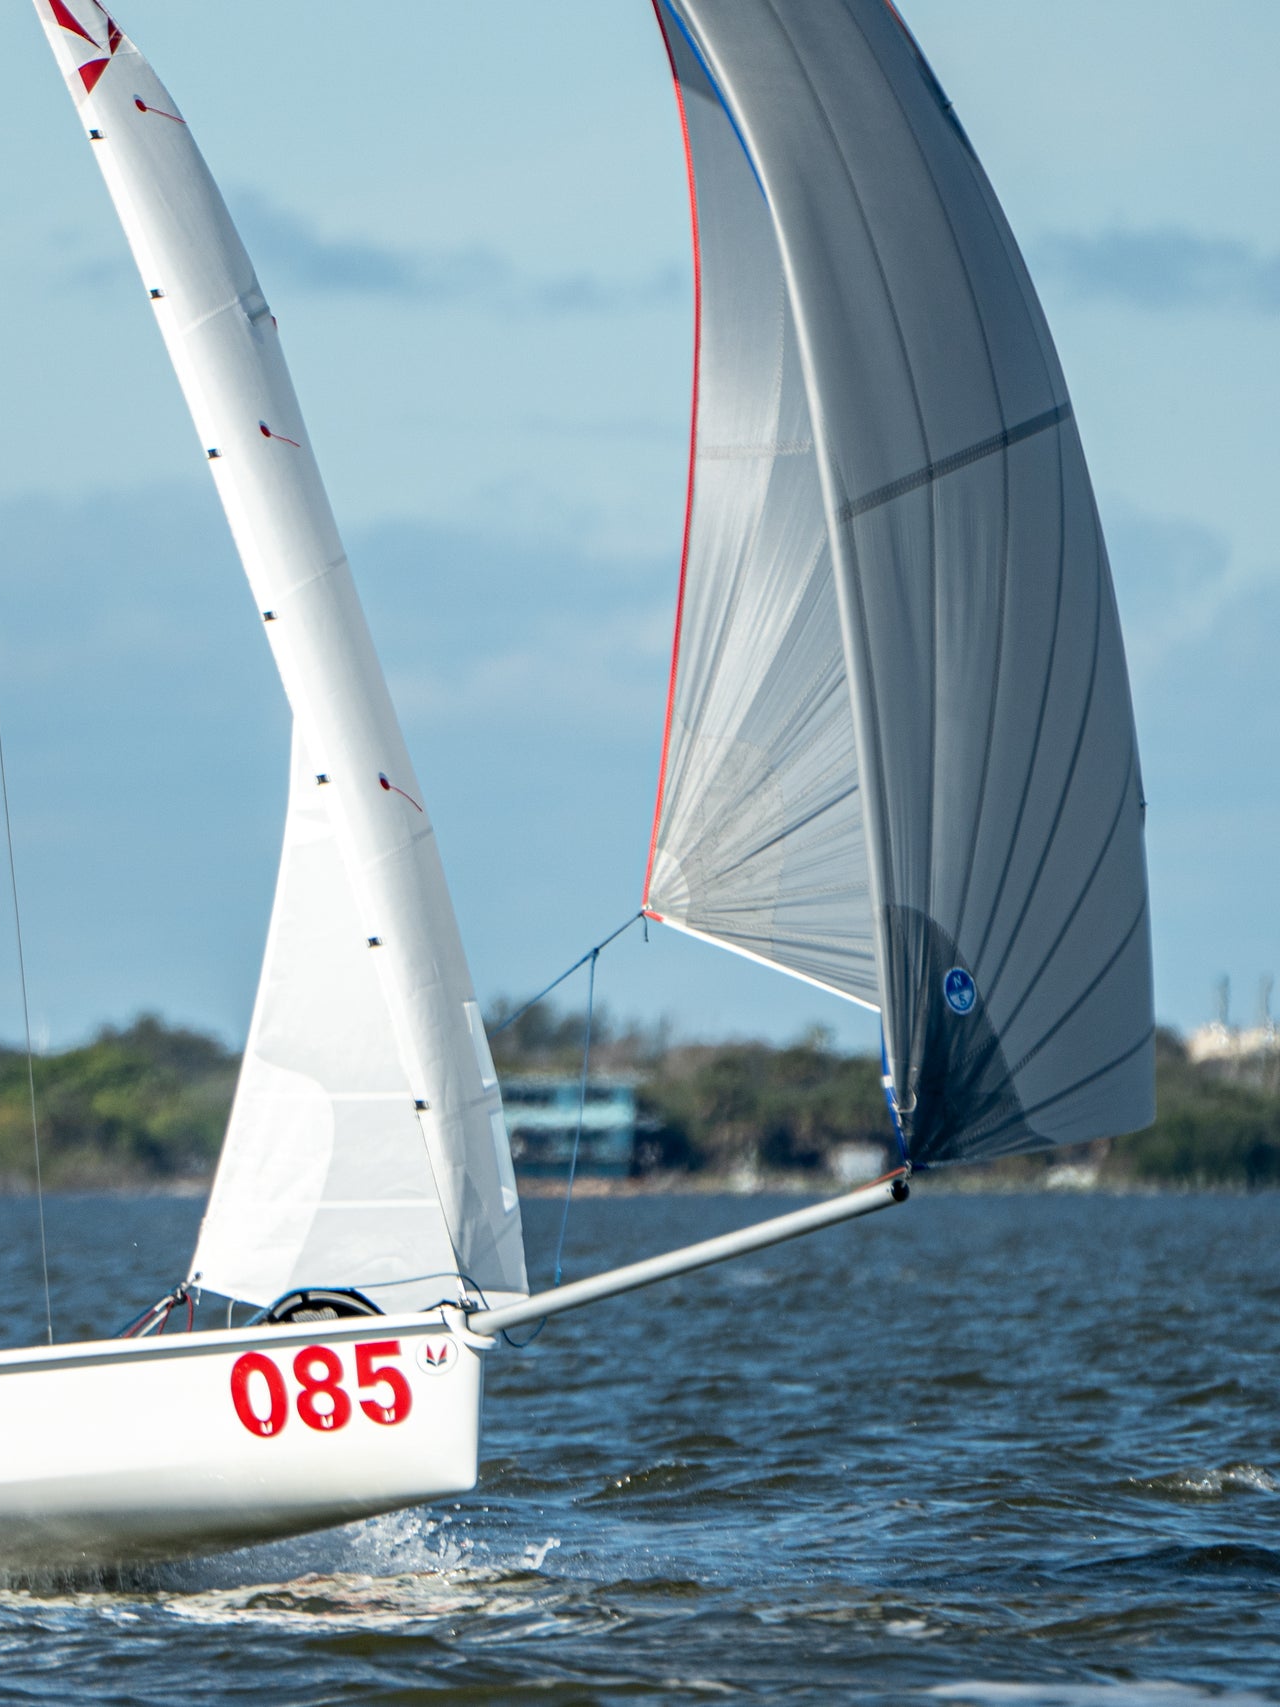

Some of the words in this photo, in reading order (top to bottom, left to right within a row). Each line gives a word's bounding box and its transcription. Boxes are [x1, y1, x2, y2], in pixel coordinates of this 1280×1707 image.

[953, 974, 963, 988] N
[958, 993, 968, 1006] S
[230, 1340, 413, 1438] 085
